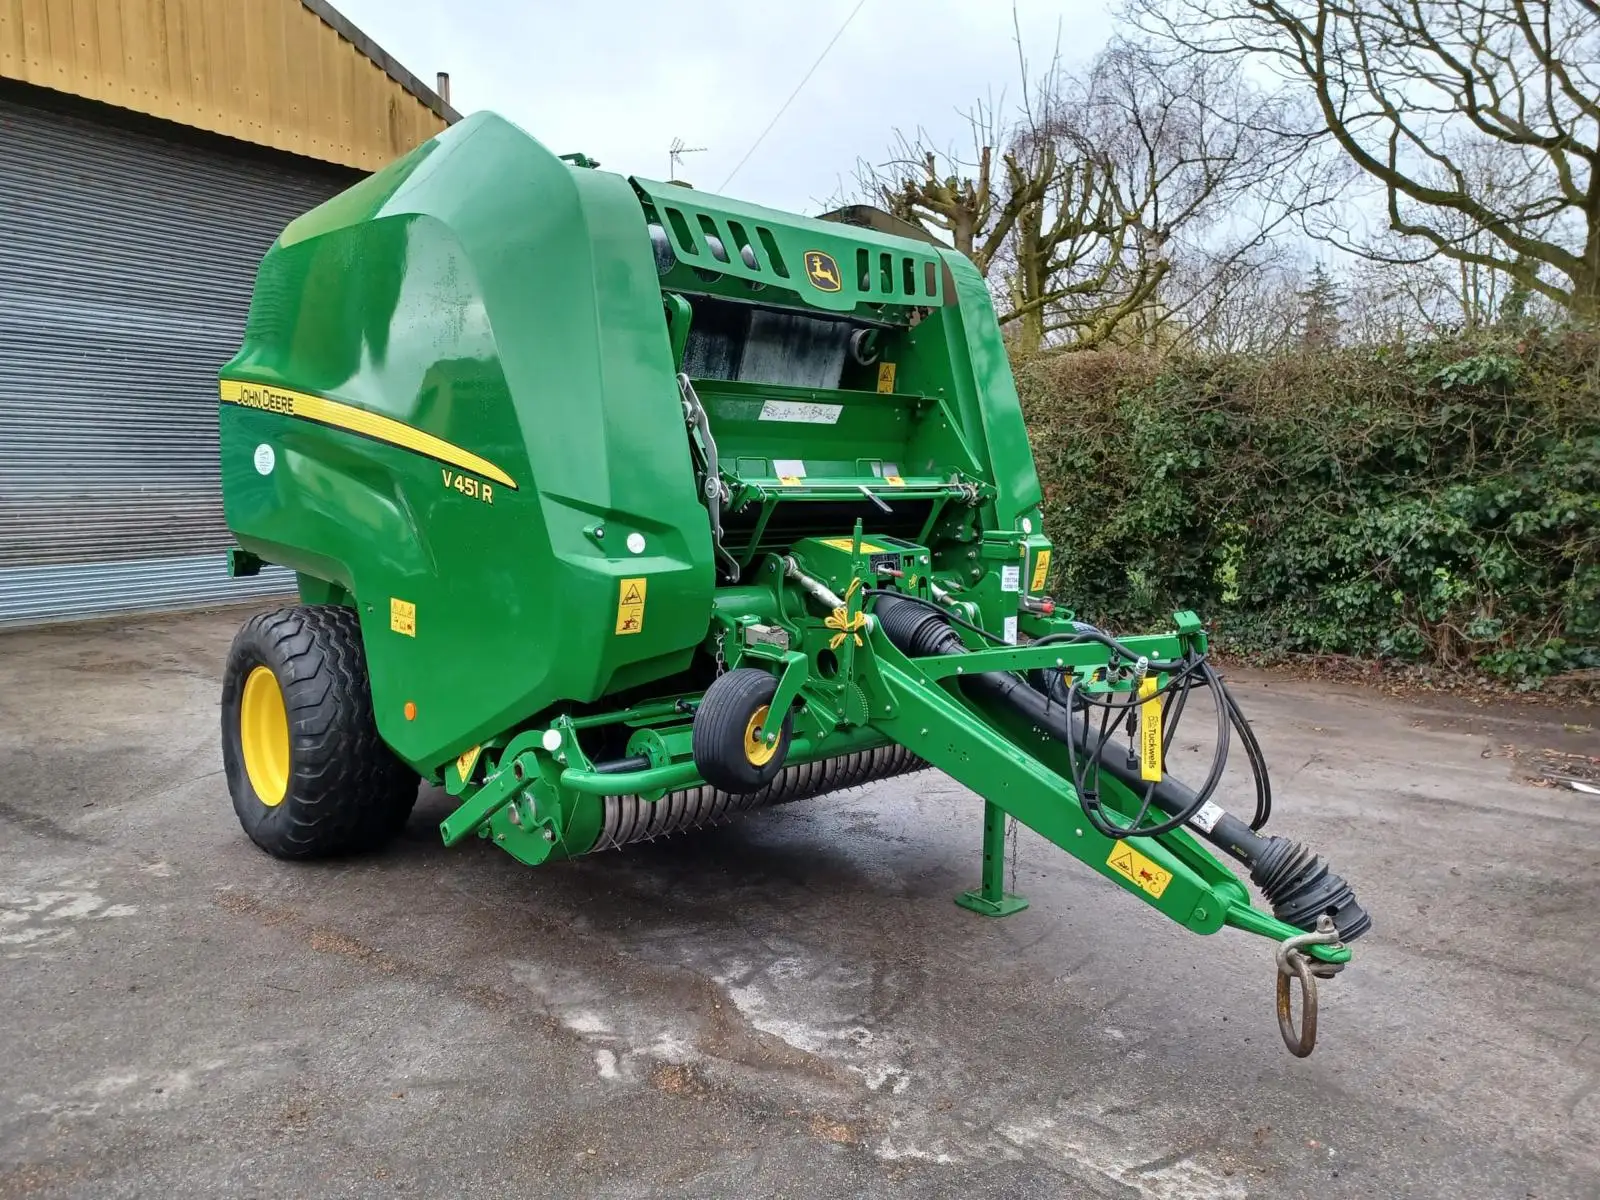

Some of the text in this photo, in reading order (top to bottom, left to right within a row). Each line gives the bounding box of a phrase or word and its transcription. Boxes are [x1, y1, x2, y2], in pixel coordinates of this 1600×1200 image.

[238, 385, 294, 413] JOHN DEERE
[442, 469, 493, 504] V 451 R
[1149, 728, 1157, 769] Tuckwells
